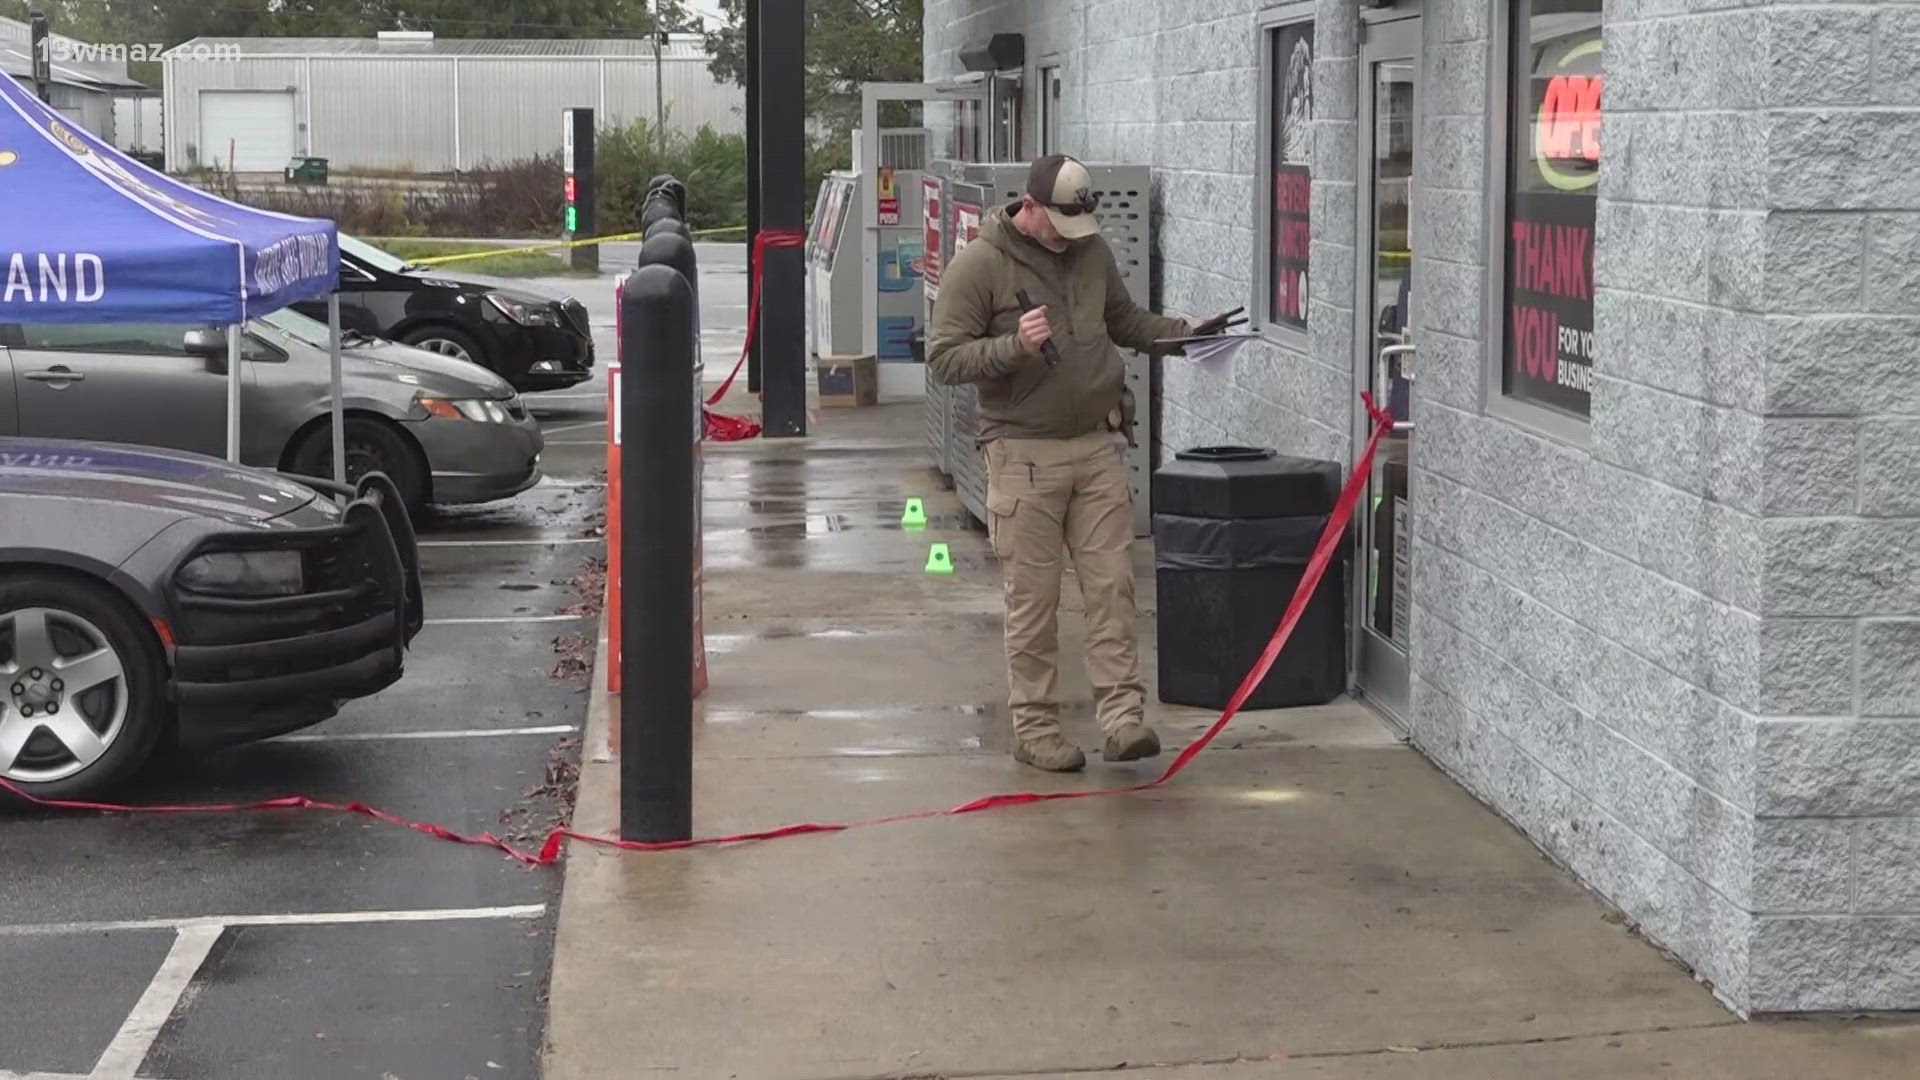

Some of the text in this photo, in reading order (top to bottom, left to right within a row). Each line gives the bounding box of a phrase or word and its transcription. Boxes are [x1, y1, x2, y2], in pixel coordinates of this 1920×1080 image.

[879, 212, 898, 224] PUSH
[3, 252, 105, 302] AND
[1512, 221, 1589, 301] THANK
[1512, 304, 1557, 382] YOU
[1558, 325, 1594, 358] FOR YO
[1557, 359, 1592, 394] BUSINE
